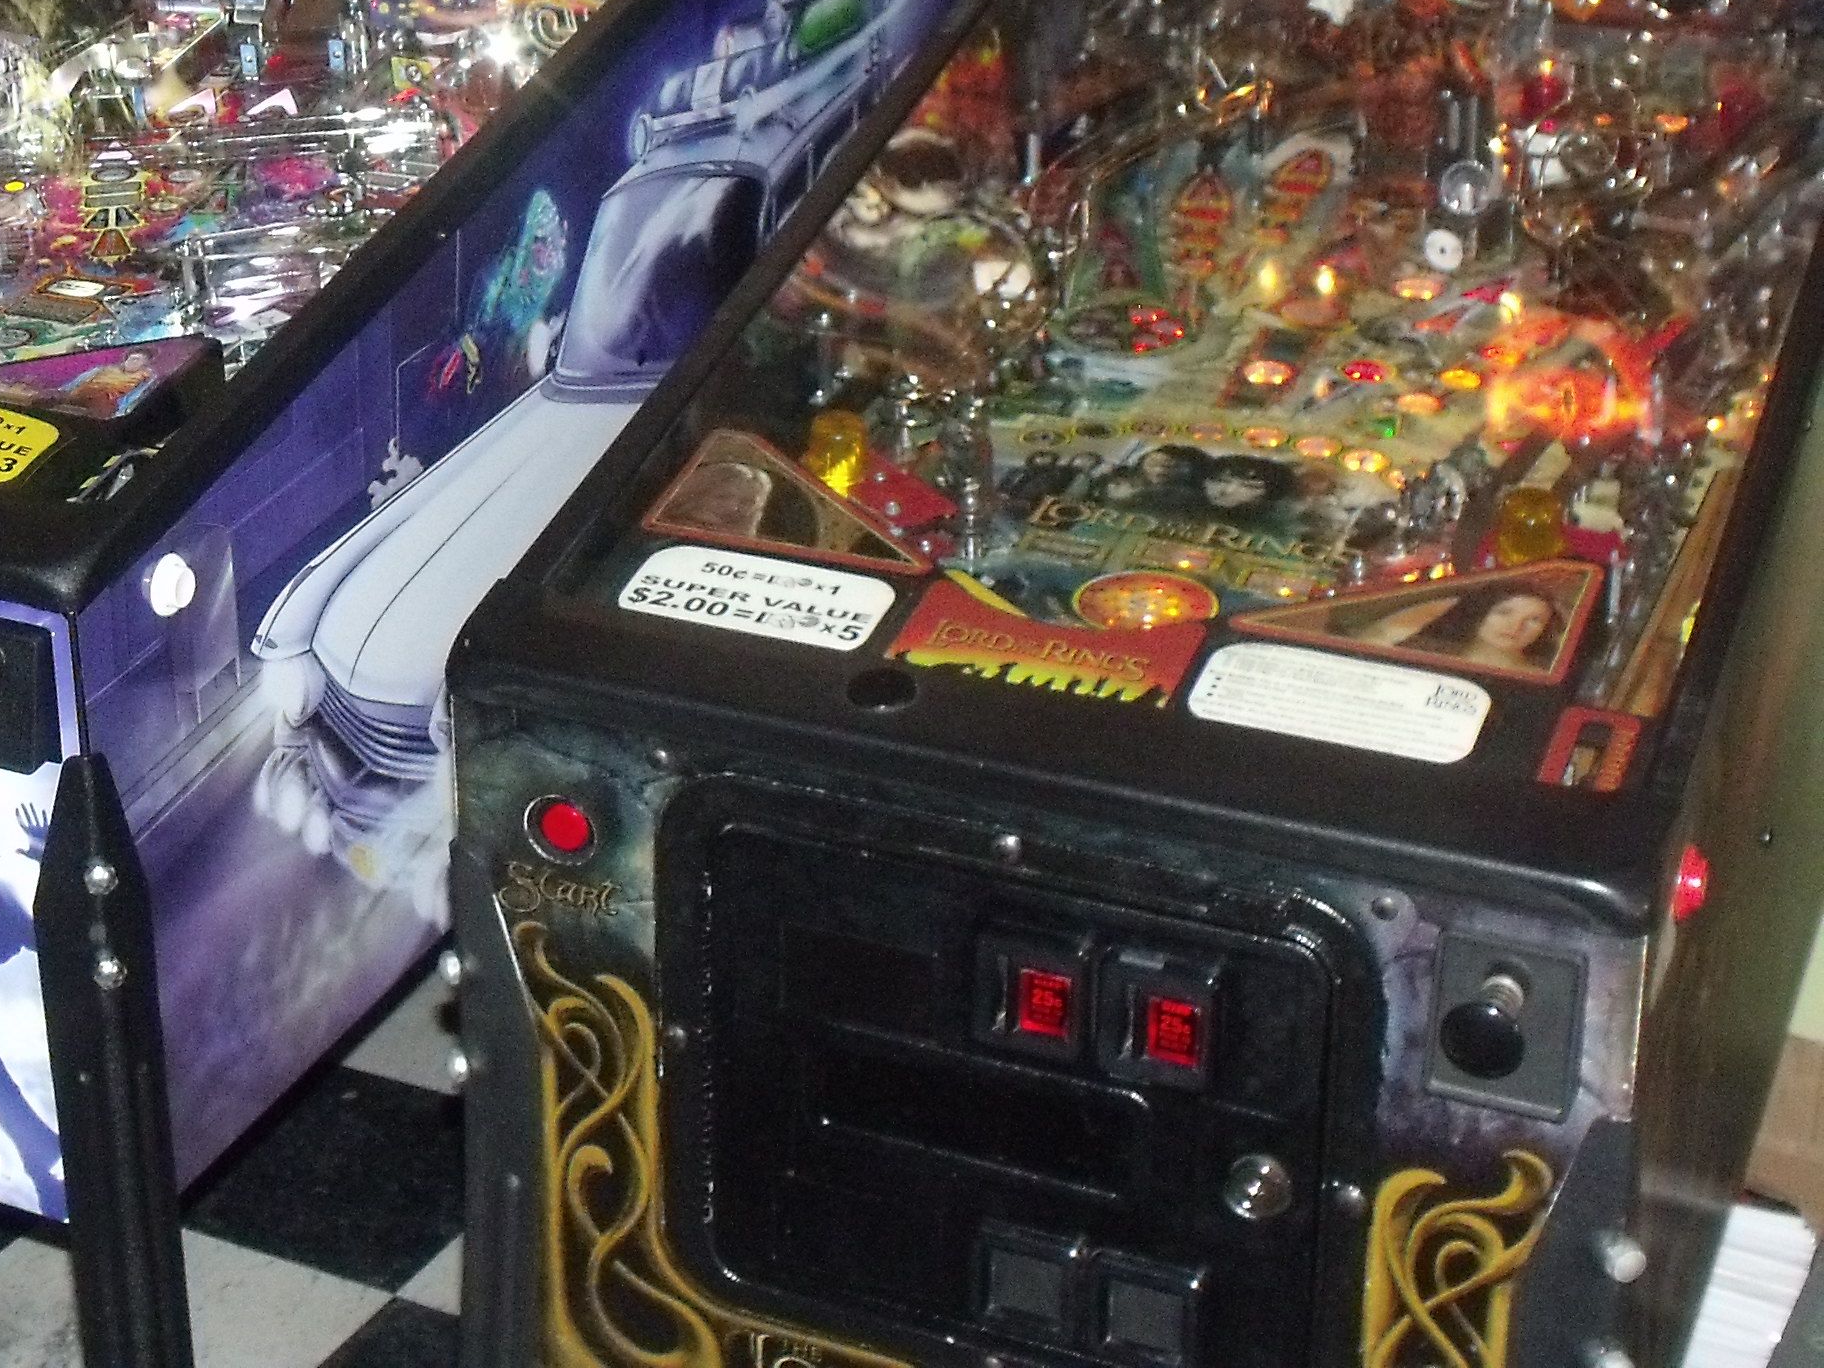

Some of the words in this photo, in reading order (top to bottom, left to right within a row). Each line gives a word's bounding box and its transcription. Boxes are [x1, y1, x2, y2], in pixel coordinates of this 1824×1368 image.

[640, 574, 753, 603] SUPER
[763, 595, 874, 625] VALUE
[926, 618, 1017, 652] LORD
[1037, 638, 1152, 682] RINGS
